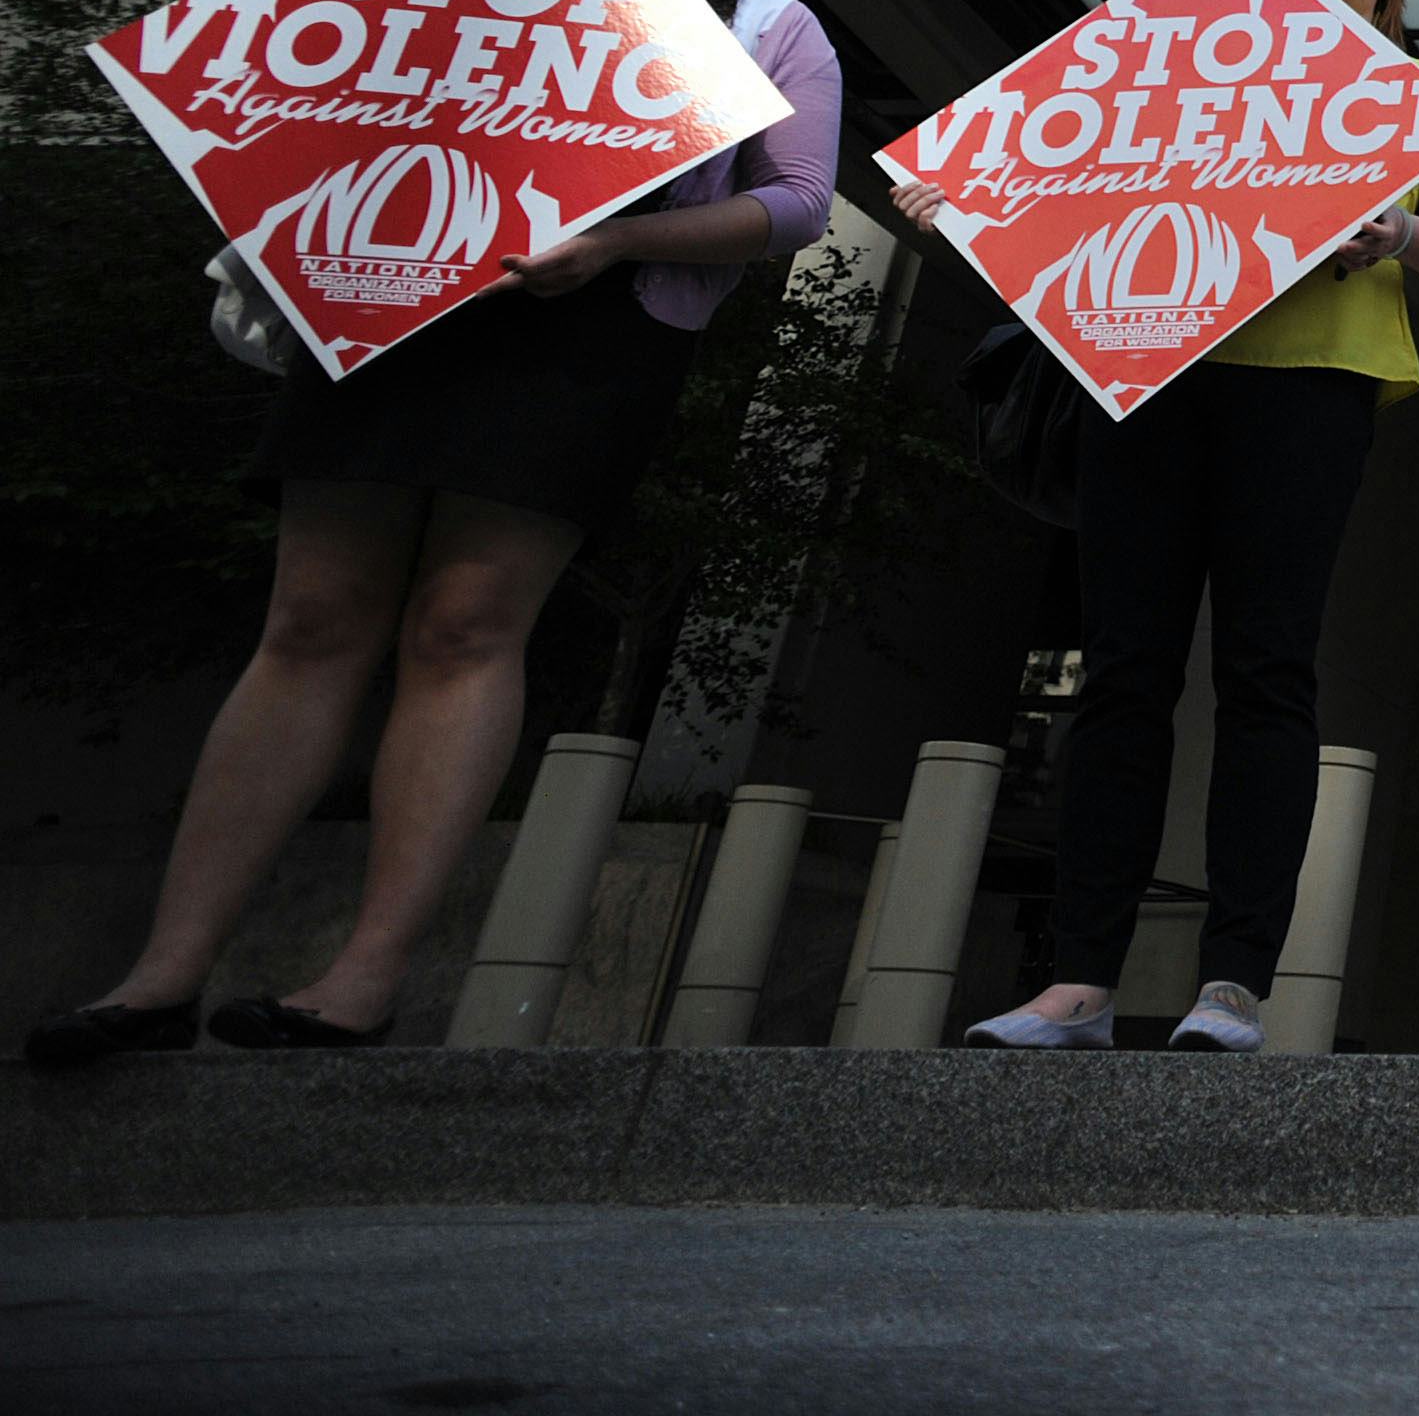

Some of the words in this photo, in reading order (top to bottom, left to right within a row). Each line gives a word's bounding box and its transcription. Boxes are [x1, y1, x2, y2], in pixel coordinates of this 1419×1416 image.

[1061, 13, 1343, 90] STOP
[186, 69, 446, 135] Against
[456, 86, 677, 152] Women
[295, 144, 500, 265] NOW
[959, 156, 1178, 214] Against
[1192, 146, 1389, 189] Women
[301, 259, 461, 281] NATIONAL
[1064, 202, 1241, 311] NOW
[1072, 311, 1215, 325] NATIONAL
